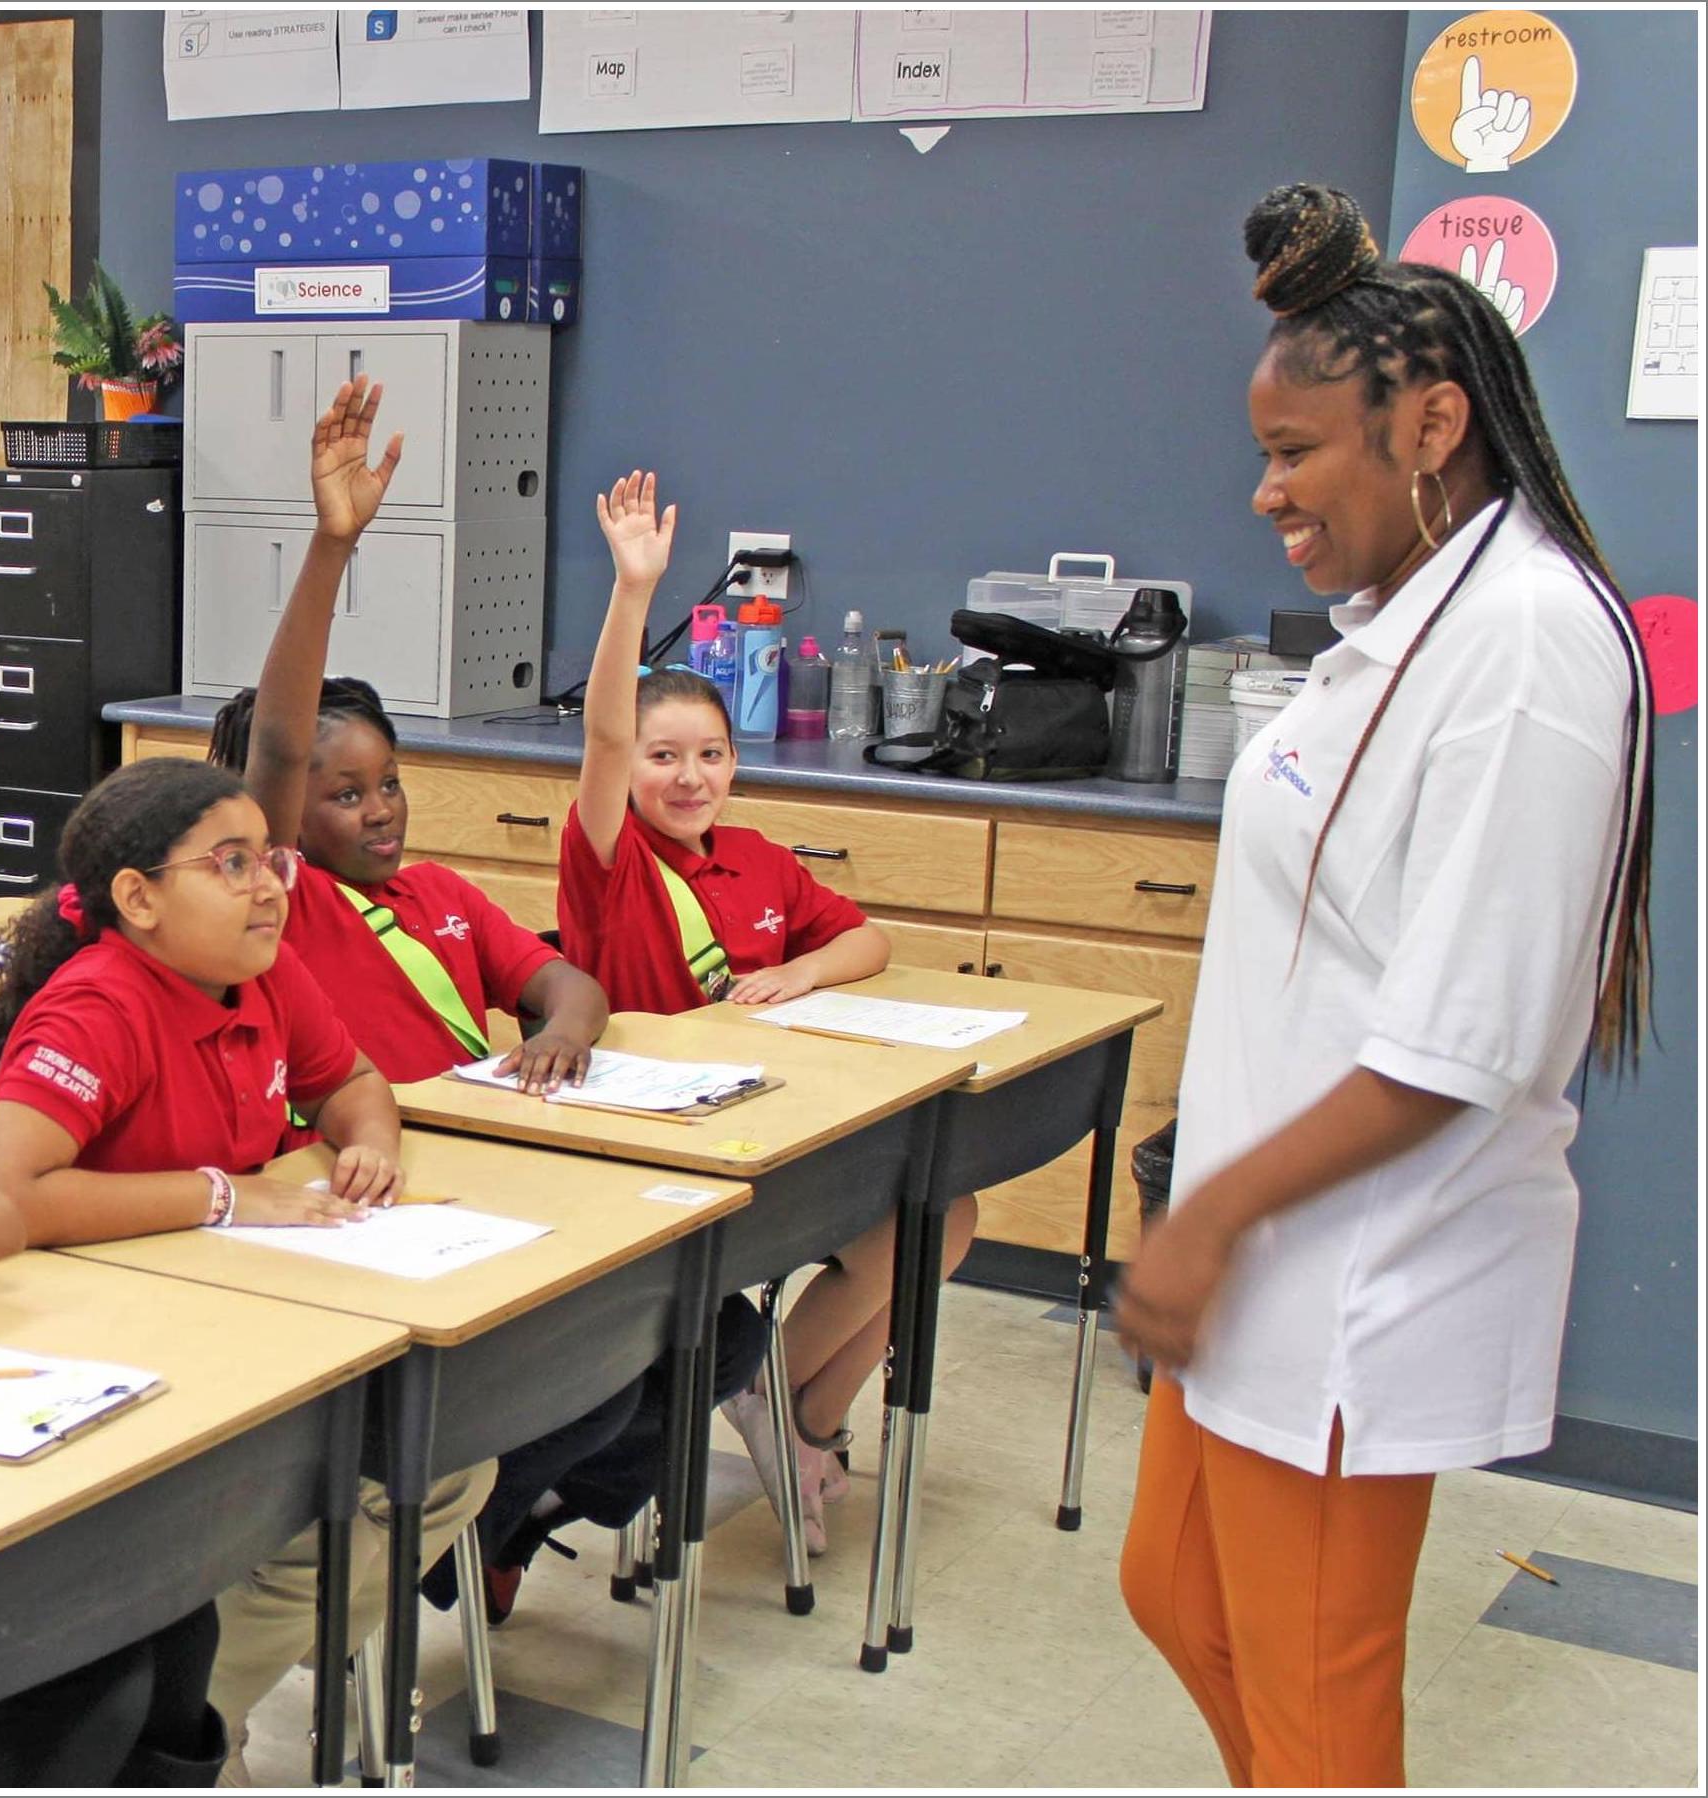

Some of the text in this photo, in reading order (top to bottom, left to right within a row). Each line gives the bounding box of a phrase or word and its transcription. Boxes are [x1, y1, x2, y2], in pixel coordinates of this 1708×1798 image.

[245, 28, 272, 38] reading
[273, 22, 325, 35] STRATEGIES
[374, 20, 384, 34] S
[185, 39, 194, 52] S
[1445, 27, 1552, 49] restroom
[596, 60, 626, 78] Map
[897, 61, 941, 79] Index
[1440, 213, 1523, 238] tissue
[298, 281, 362, 298] Science
[27, 1058, 56, 1079] GOOD
